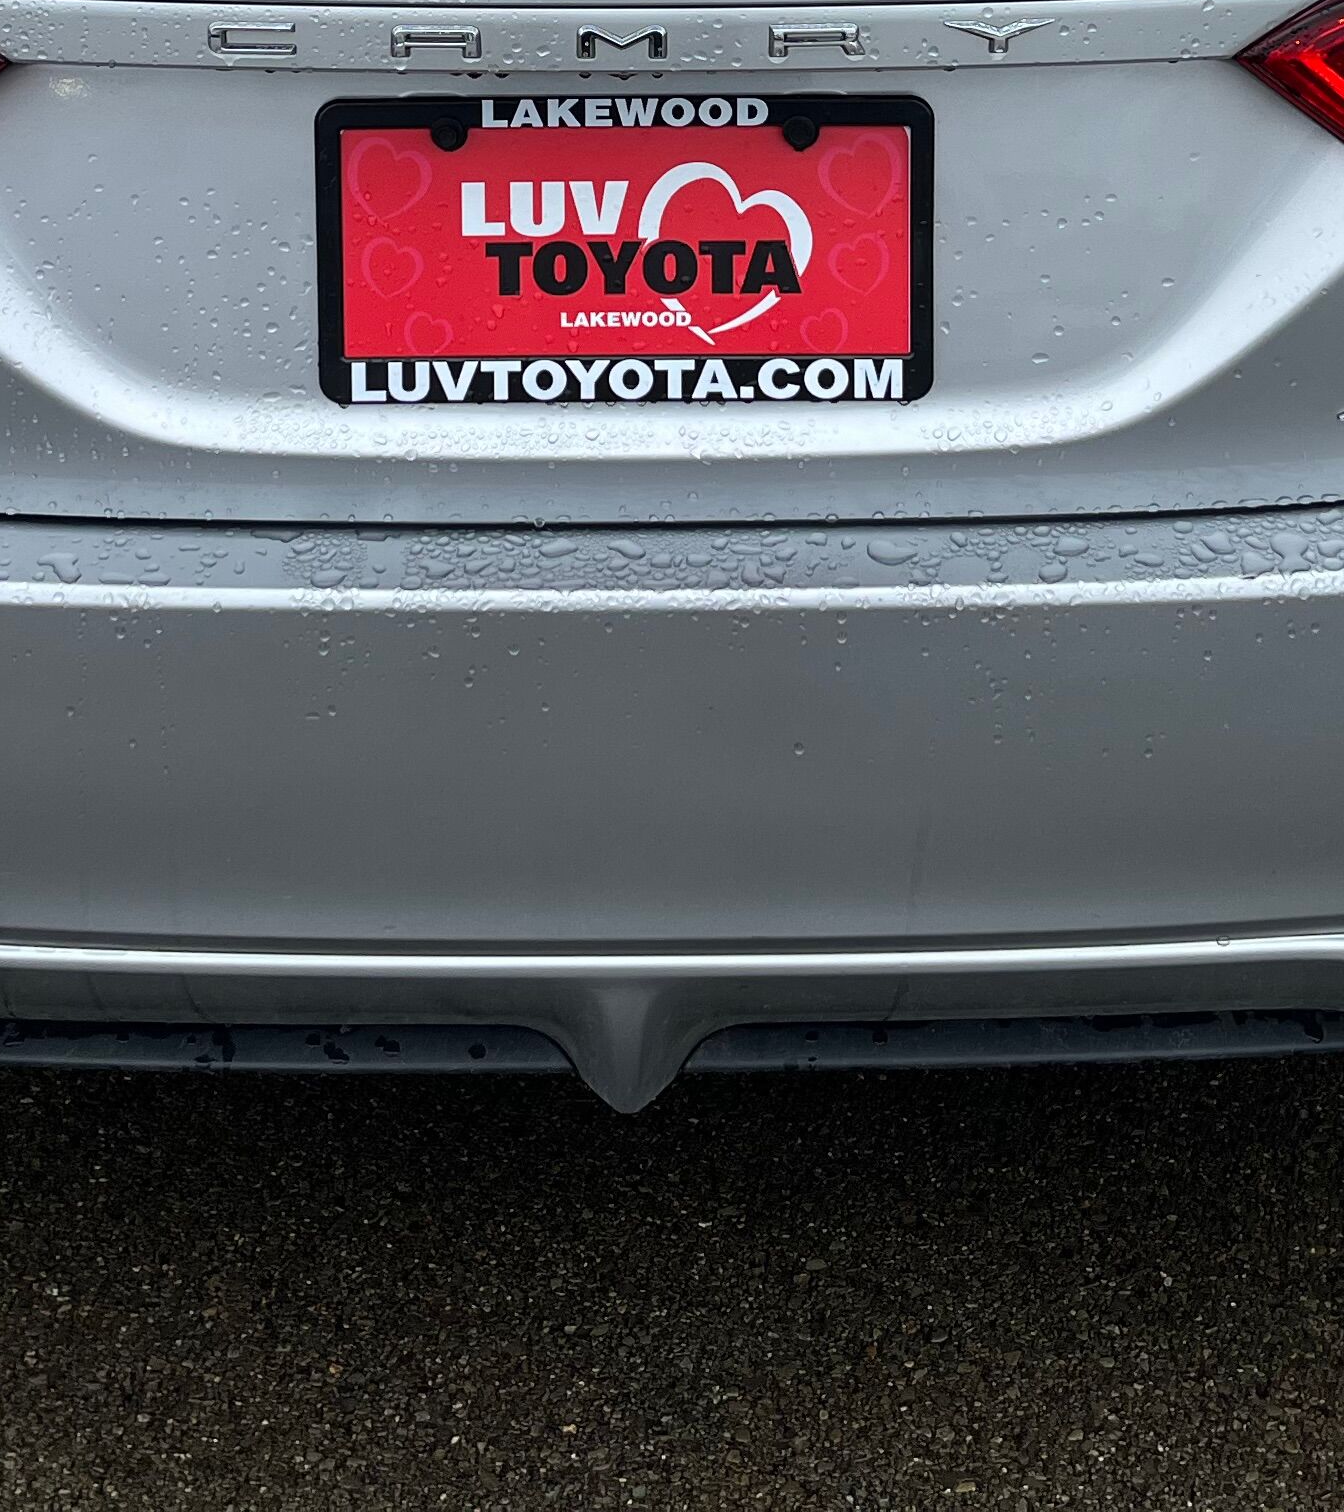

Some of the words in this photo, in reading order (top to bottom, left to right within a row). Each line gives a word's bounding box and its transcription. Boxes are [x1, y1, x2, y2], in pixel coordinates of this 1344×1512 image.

[208, 19, 1056, 58] CAMRY
[481, 98, 769, 128] LAKEWOOD
[461, 181, 629, 237] LUV
[485, 240, 802, 296] TOYOTA
[560, 311, 692, 329] LAKEWOOD
[350, 359, 904, 402] LUVTOYOTA.COM
